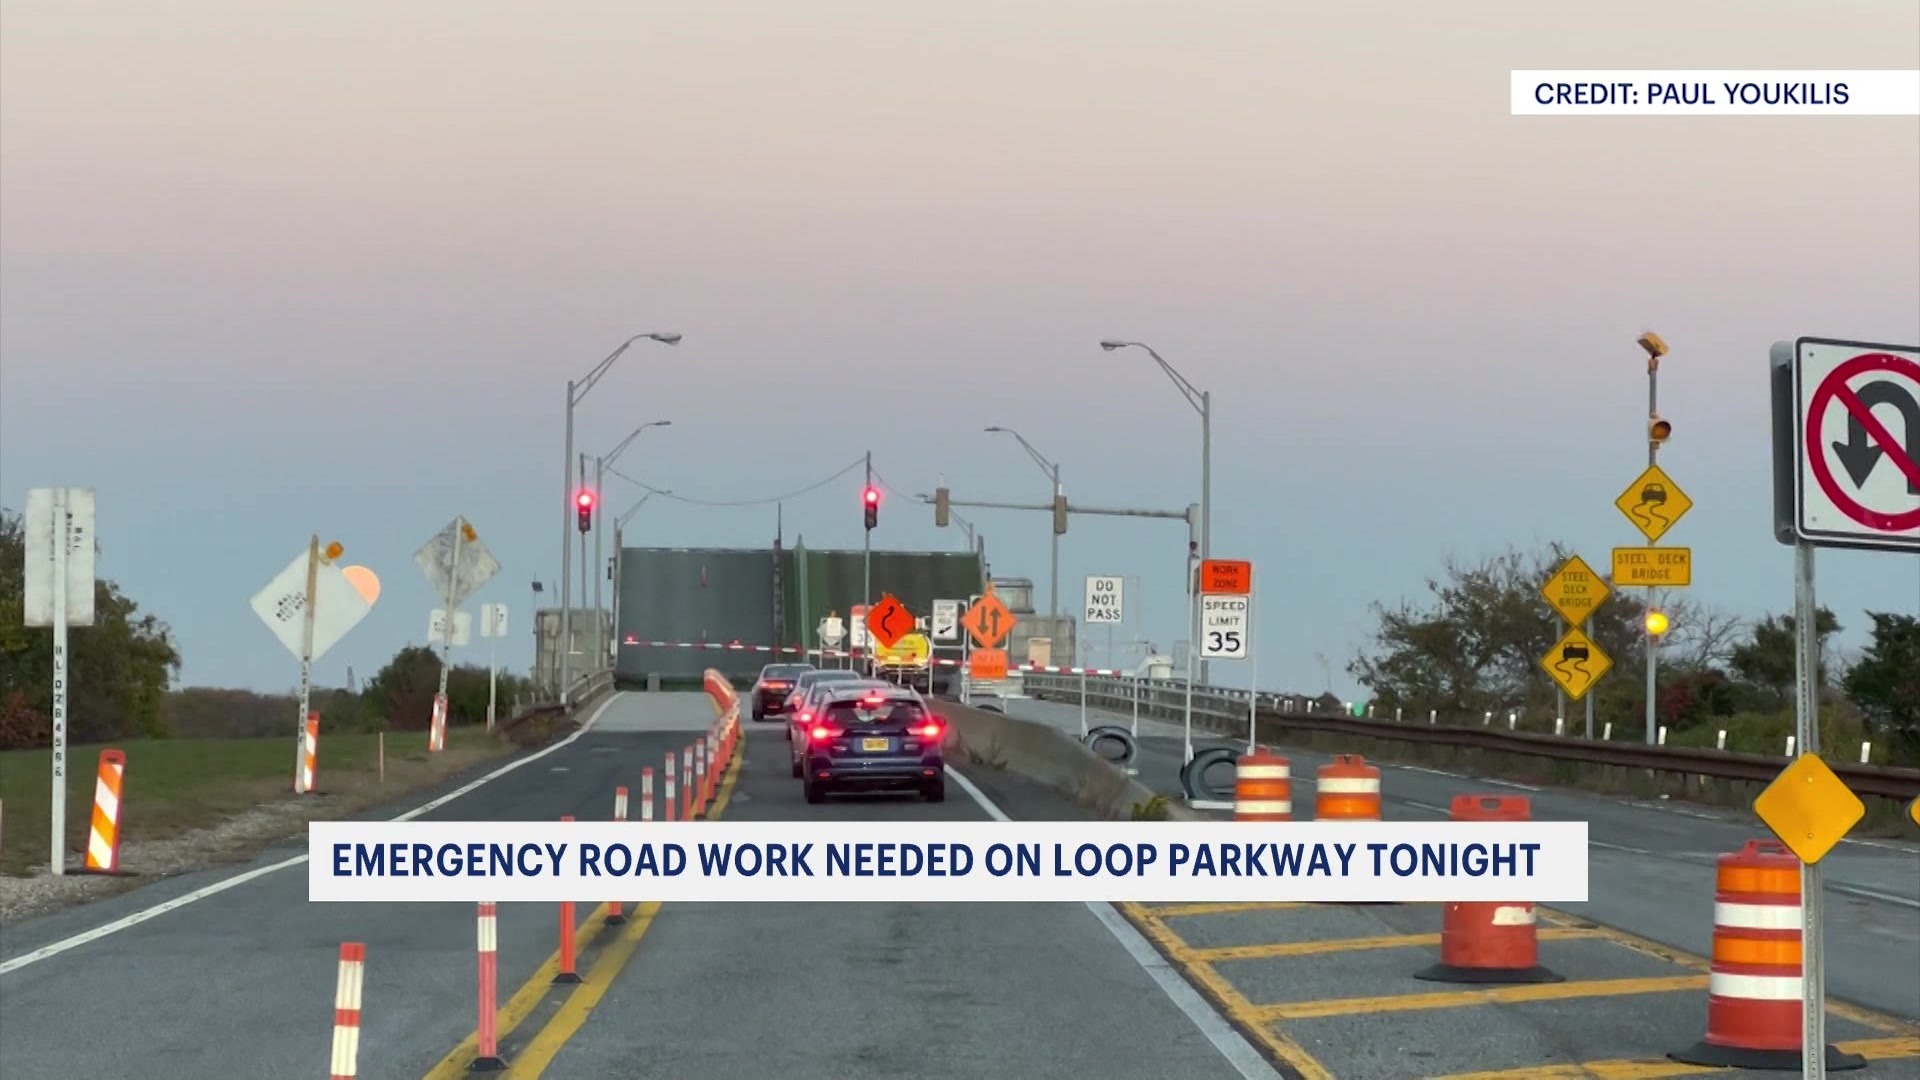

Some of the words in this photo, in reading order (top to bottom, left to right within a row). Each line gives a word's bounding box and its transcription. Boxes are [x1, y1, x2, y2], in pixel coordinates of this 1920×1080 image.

[1617, 553, 1649, 564] STEEL
[1657, 553, 1687, 564] DECK
[1212, 565, 1239, 575] WORK
[1631, 567, 1672, 579] BRIDGE
[1561, 571, 1590, 582] STEEL
[1095, 579, 1114, 592] DO
[1212, 578, 1239, 588] ZONE
[1563, 584, 1588, 594] DECK
[1091, 593, 1117, 606] NOT
[1558, 597, 1593, 608] BRIDGE
[1204, 601, 1246, 611] SPEED
[1087, 607, 1121, 620] PASS
[1208, 616, 1240, 627] LIMIT
[1207, 630, 1241, 653] 35
